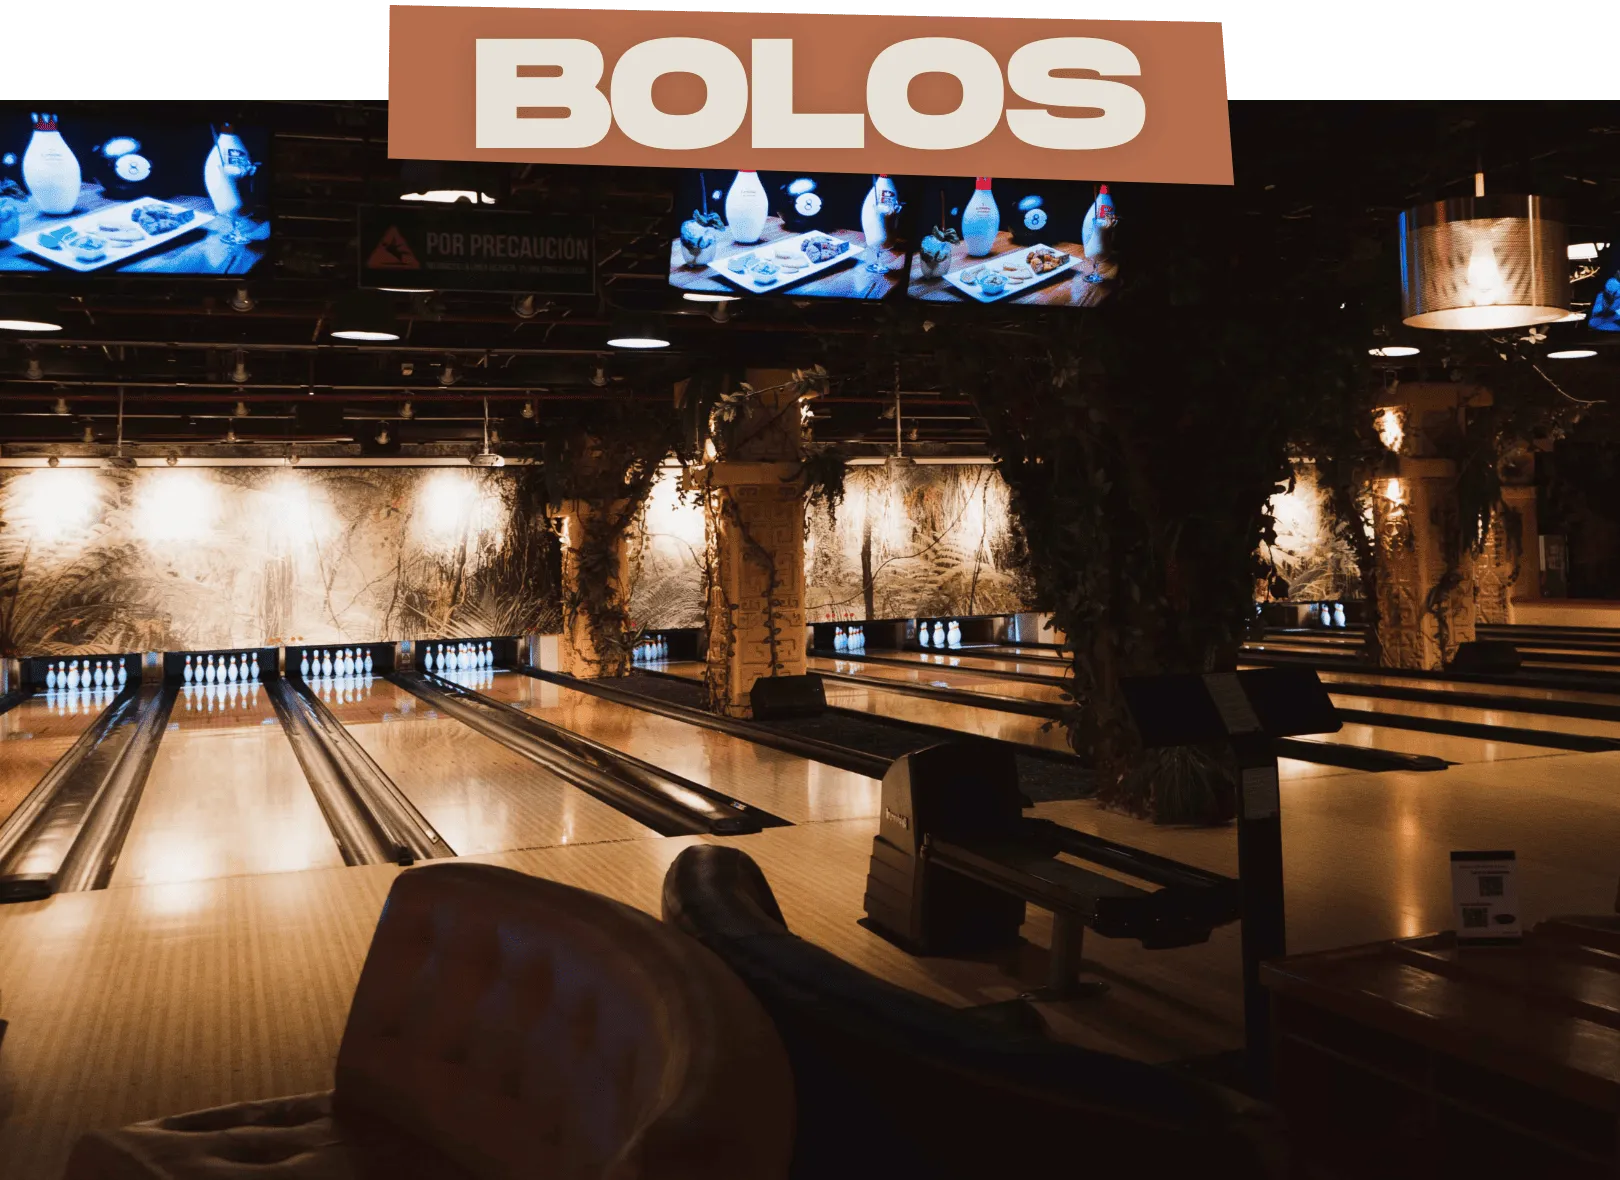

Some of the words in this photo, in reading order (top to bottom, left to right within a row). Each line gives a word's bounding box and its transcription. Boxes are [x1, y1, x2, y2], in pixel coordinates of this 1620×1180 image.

[127, 161, 139, 176] 8
[804, 199, 813, 211] 8
[1032, 214, 1040, 225] 8
[426, 232, 465, 256] POR
[470, 233, 589, 261] PRECAUCIÓN
